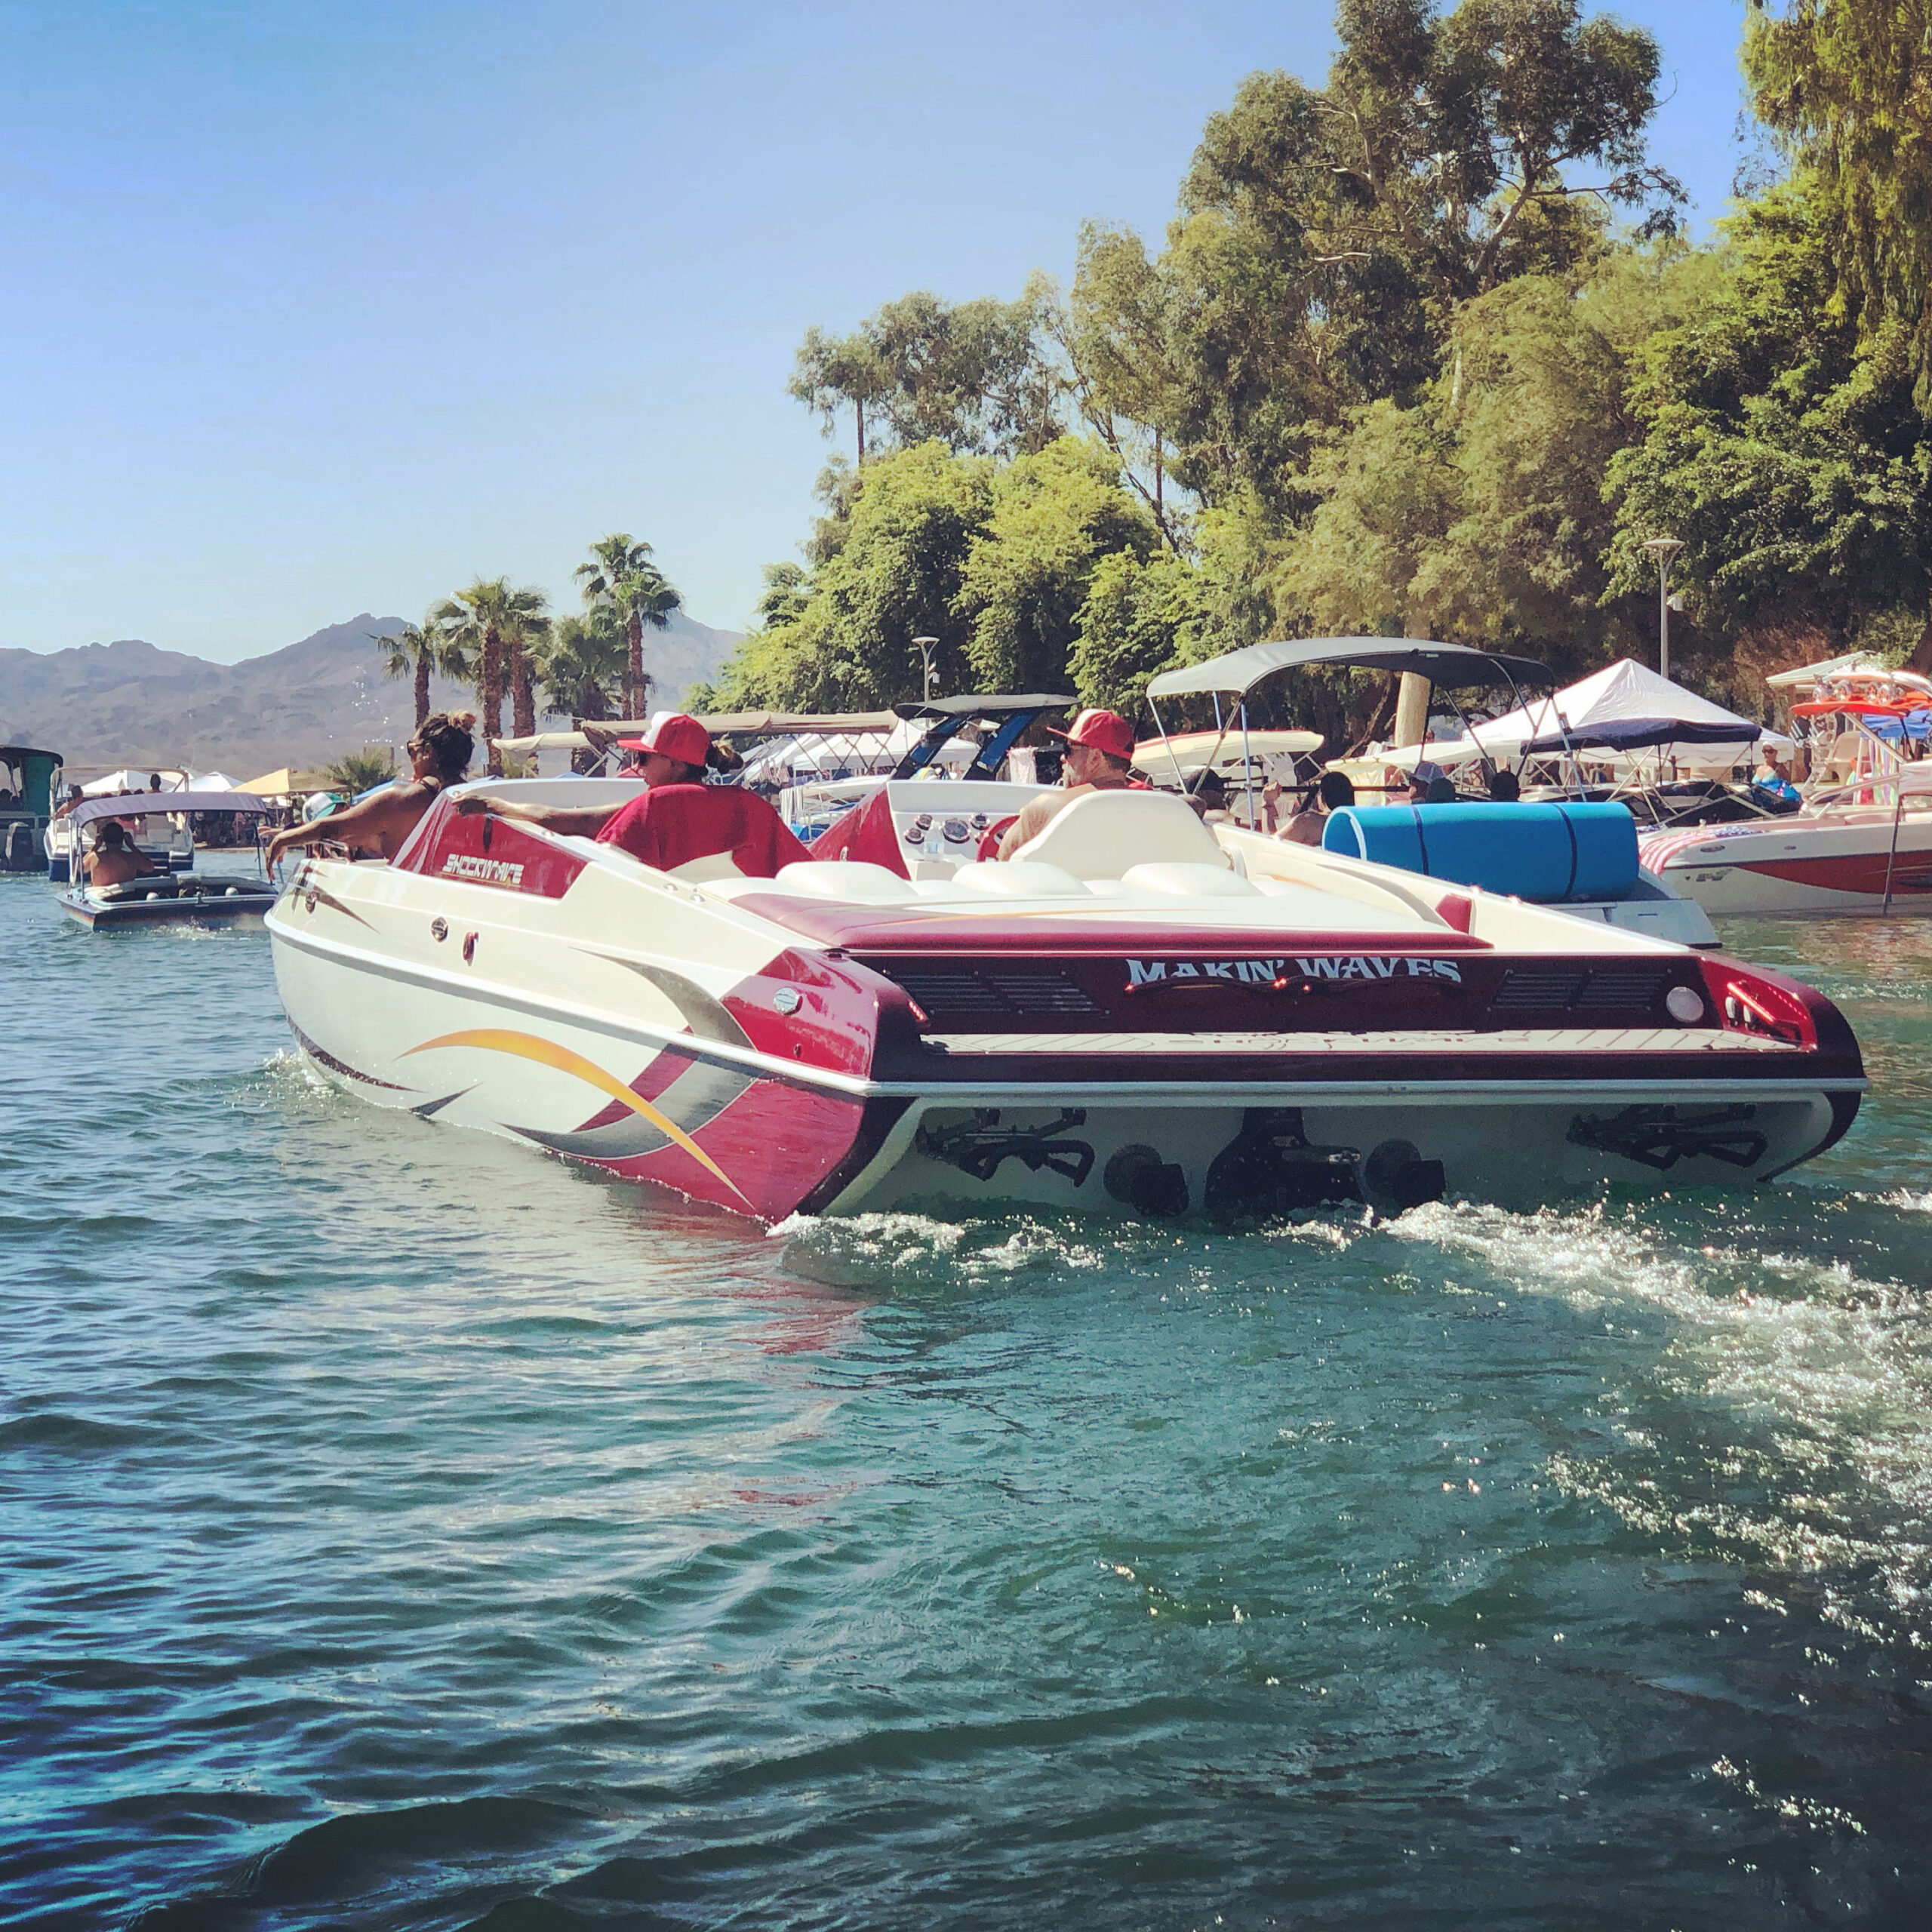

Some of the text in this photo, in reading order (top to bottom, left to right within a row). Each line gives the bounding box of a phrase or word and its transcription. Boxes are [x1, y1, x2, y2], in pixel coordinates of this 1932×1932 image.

[442, 854, 525, 884] SHOCKWAVE
[1125, 956, 1462, 984] MAKIN' WAVES
